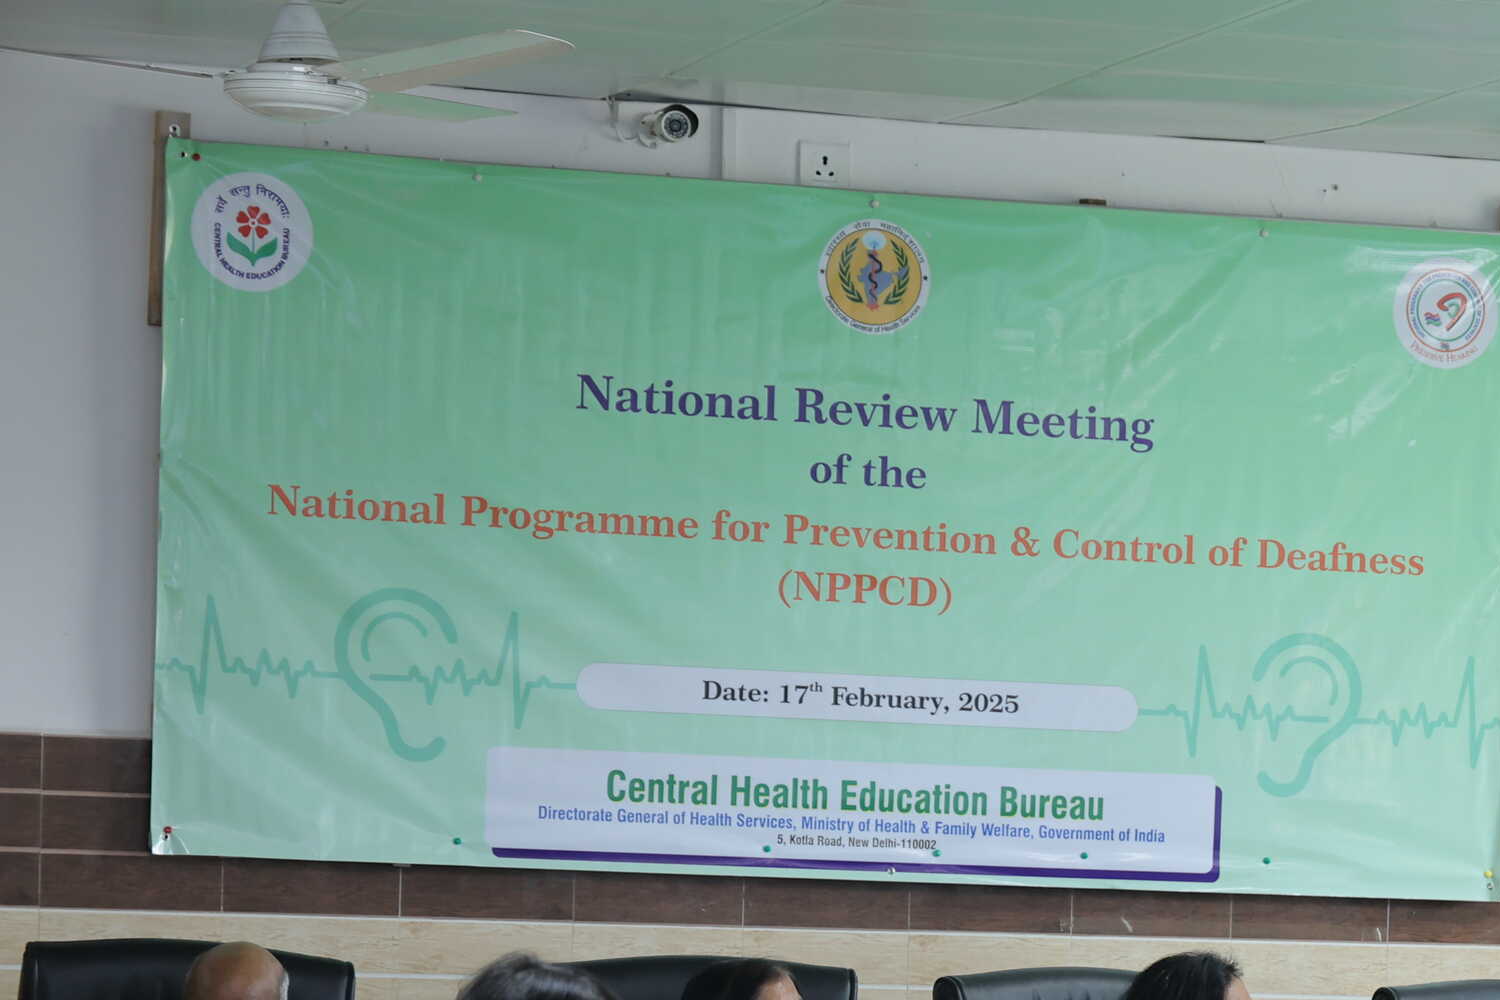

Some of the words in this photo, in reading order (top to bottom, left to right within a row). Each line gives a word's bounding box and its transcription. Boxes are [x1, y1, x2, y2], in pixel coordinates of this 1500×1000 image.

[214, 222, 223, 258] CENTRAL
[219, 257, 245, 279] HEALTH
[245, 260, 286, 280] EDUCATION
[281, 227, 290, 261] BUREAU
[576, 374, 778, 421] National
[794, 387, 958, 432] Review
[971, 398, 1155, 453] Meeting
[810, 453, 852, 485] of
[862, 455, 927, 489] the
[267, 484, 447, 525] National
[460, 495, 699, 539] Programme
[711, 509, 770, 543] for
[783, 513, 997, 555] Prevention
[1009, 525, 1041, 558] &
[1052, 528, 1196, 566] Control
[1207, 537, 1248, 568] of
[1256, 538, 1425, 576] Deafness
[778, 569, 952, 615] (NPPCD)
[702, 679, 769, 702] Date:
[779, 681, 823, 705] 17th
[831, 685, 950, 716] February,
[958, 692, 1020, 714] 2025
[606, 769, 718, 806] Central
[730, 774, 829, 810] Health
[840, 779, 988, 816] Education
[999, 785, 1105, 821] Bureau
[538, 805, 613, 823] Directorate
[617, 808, 669, 825] General
[673, 812, 686, 825] of
[690, 812, 732, 827] Health
[736, 814, 797, 831] Services,
[801, 815, 854, 834] Ministry
[858, 819, 872, 832] of
[875, 819, 916, 834] Health
[920, 820, 930, 835] &
[935, 821, 977, 839] Family
[981, 823, 1034, 840] Welfare,
[1038, 825, 1115, 841] Government
[1118, 827, 1131, 842] of
[1134, 828, 1166, 843] India
[789, 834, 814, 846] Kotla
[817, 835, 845, 848] Road,
[848, 836, 869, 848] New
[871, 836, 937, 850] Delhi-110002
